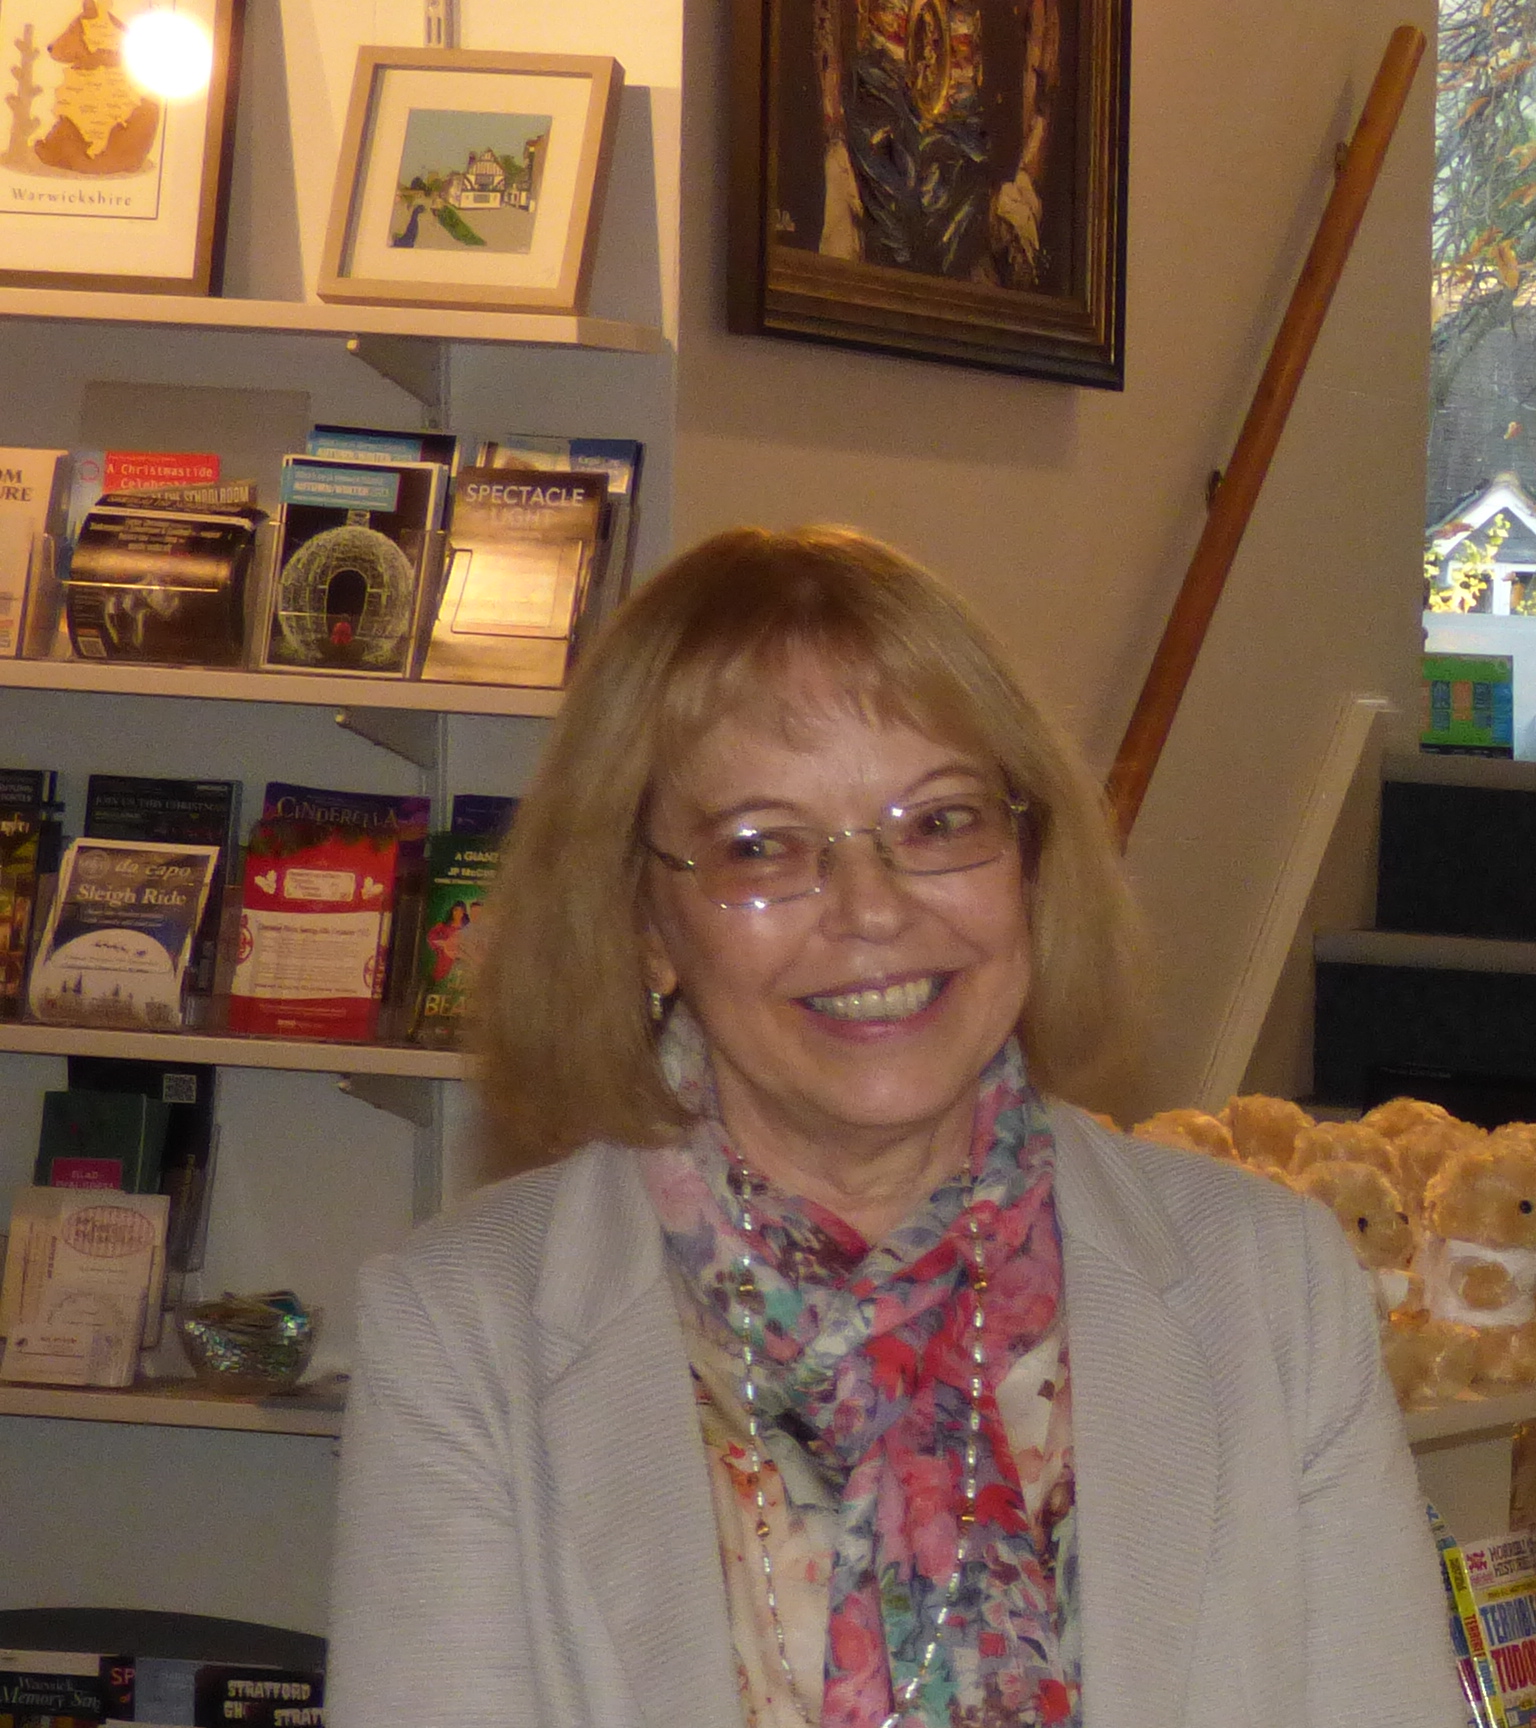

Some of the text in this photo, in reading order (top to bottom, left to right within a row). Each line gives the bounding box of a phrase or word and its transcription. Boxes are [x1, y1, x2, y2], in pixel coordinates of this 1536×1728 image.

[12, 187, 132, 206] Warwickshire
[107, 464, 214, 477] A Christmastide
[466, 483, 586, 508] SPECTACLE
[276, 796, 400, 829] CINDERELLA
[115, 859, 192, 881] da capo
[77, 884, 187, 906] Sleigh Ride
[2, 1685, 66, 1709] Memory
[227, 1679, 312, 1701] STRATFORD
